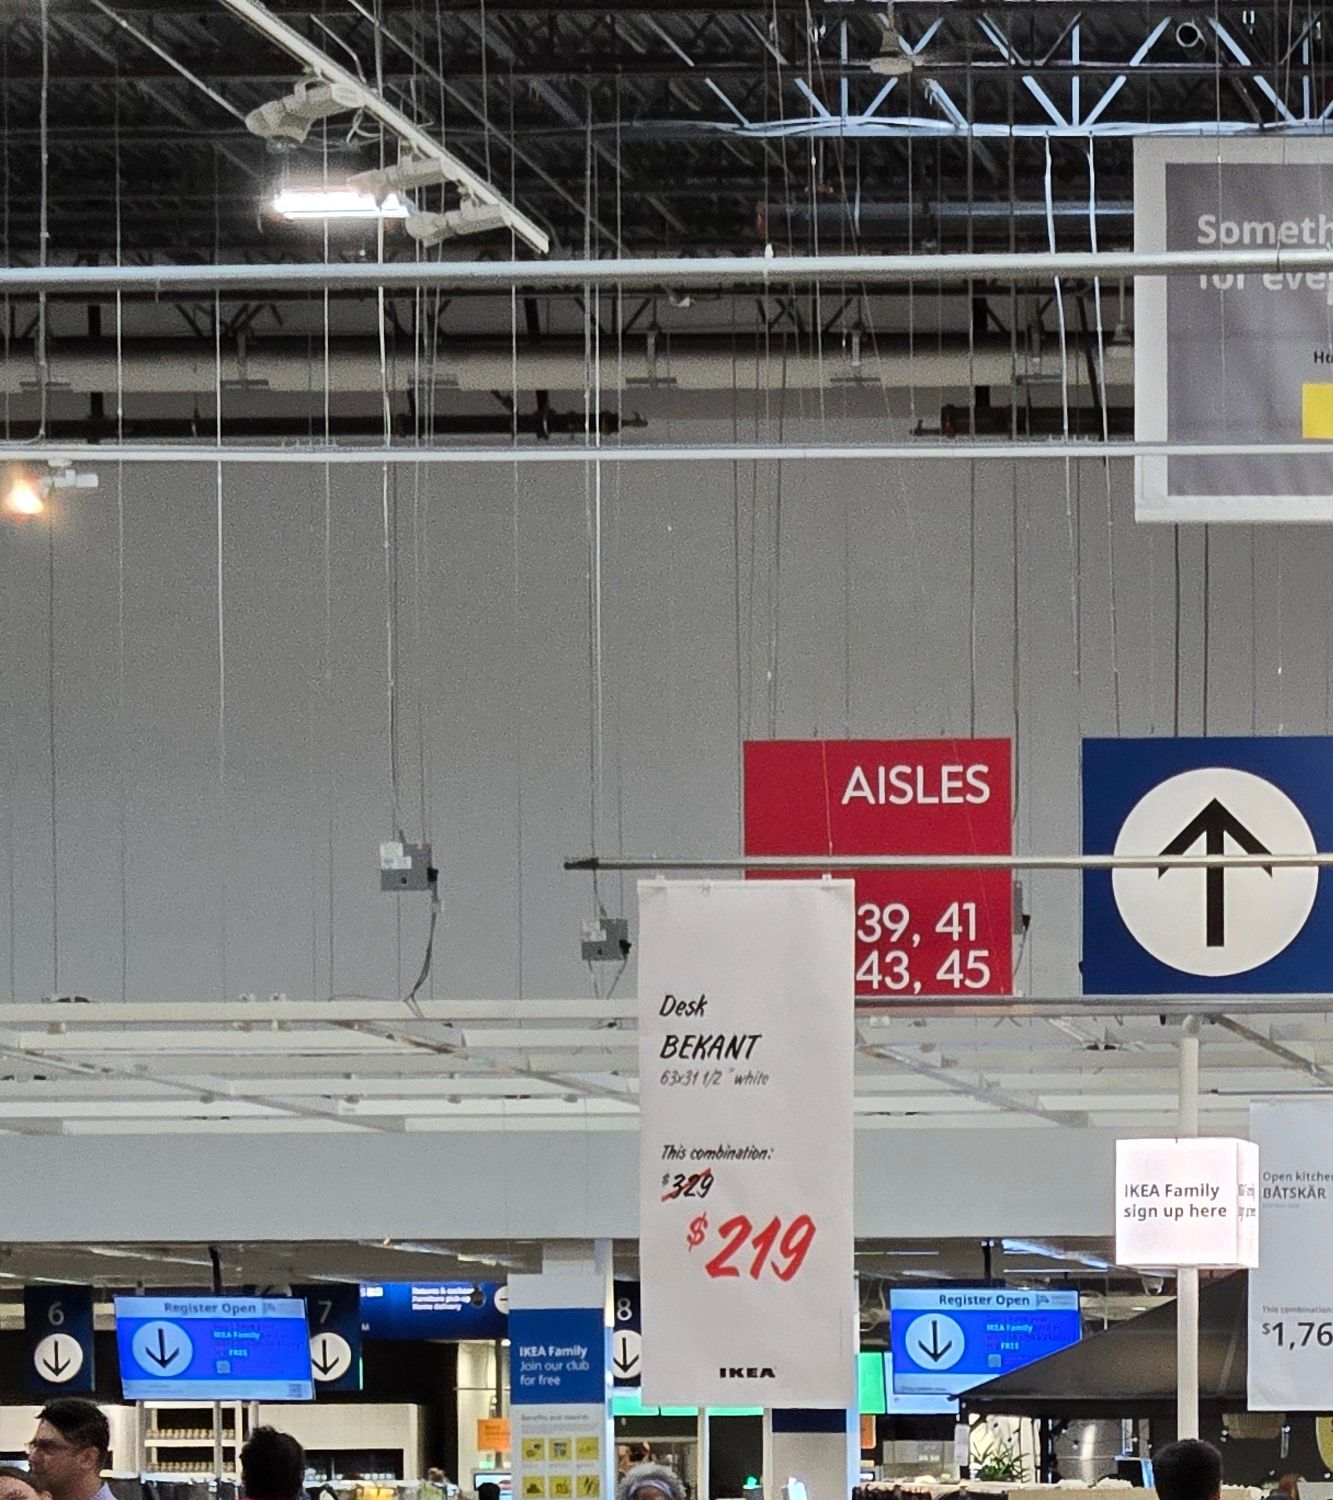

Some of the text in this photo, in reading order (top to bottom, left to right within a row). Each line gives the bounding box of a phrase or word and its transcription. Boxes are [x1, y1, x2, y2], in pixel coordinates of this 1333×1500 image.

[840, 763, 990, 806] AISLES
[855, 902, 977, 947] 39, 41
[854, 949, 991, 995] 43, 45
[659, 993, 708, 1017] Desk
[659, 1033, 763, 1061] BEKANT
[660, 1069, 698, 1086] 63x31
[702, 1069, 723, 1088] 1/2
[733, 1069, 770, 1086] white
[661, 1144, 774, 1161] This combination:
[661, 1173, 715, 1199] $329
[1262, 1172, 1293, 1184] Open
[1124, 1184, 1160, 1198] IKEA
[1165, 1183, 1220, 1201] Family
[1123, 1203, 1158, 1221] sign
[1163, 1206, 1183, 1221] up
[1189, 1202, 1227, 1218] here
[686, 1211, 818, 1282] $219
[164, 1302, 257, 1316] Register Open
[615, 1299, 633, 1322] 8
[939, 1294, 1030, 1308] Register Open
[47, 1301, 65, 1327] 6
[317, 1301, 332, 1325] 7
[519, 1345, 588, 1359] IKEA Family
[520, 1360, 590, 1372] Join our club
[719, 1366, 776, 1379] IKEA
[519, 1374, 561, 1386] for free
